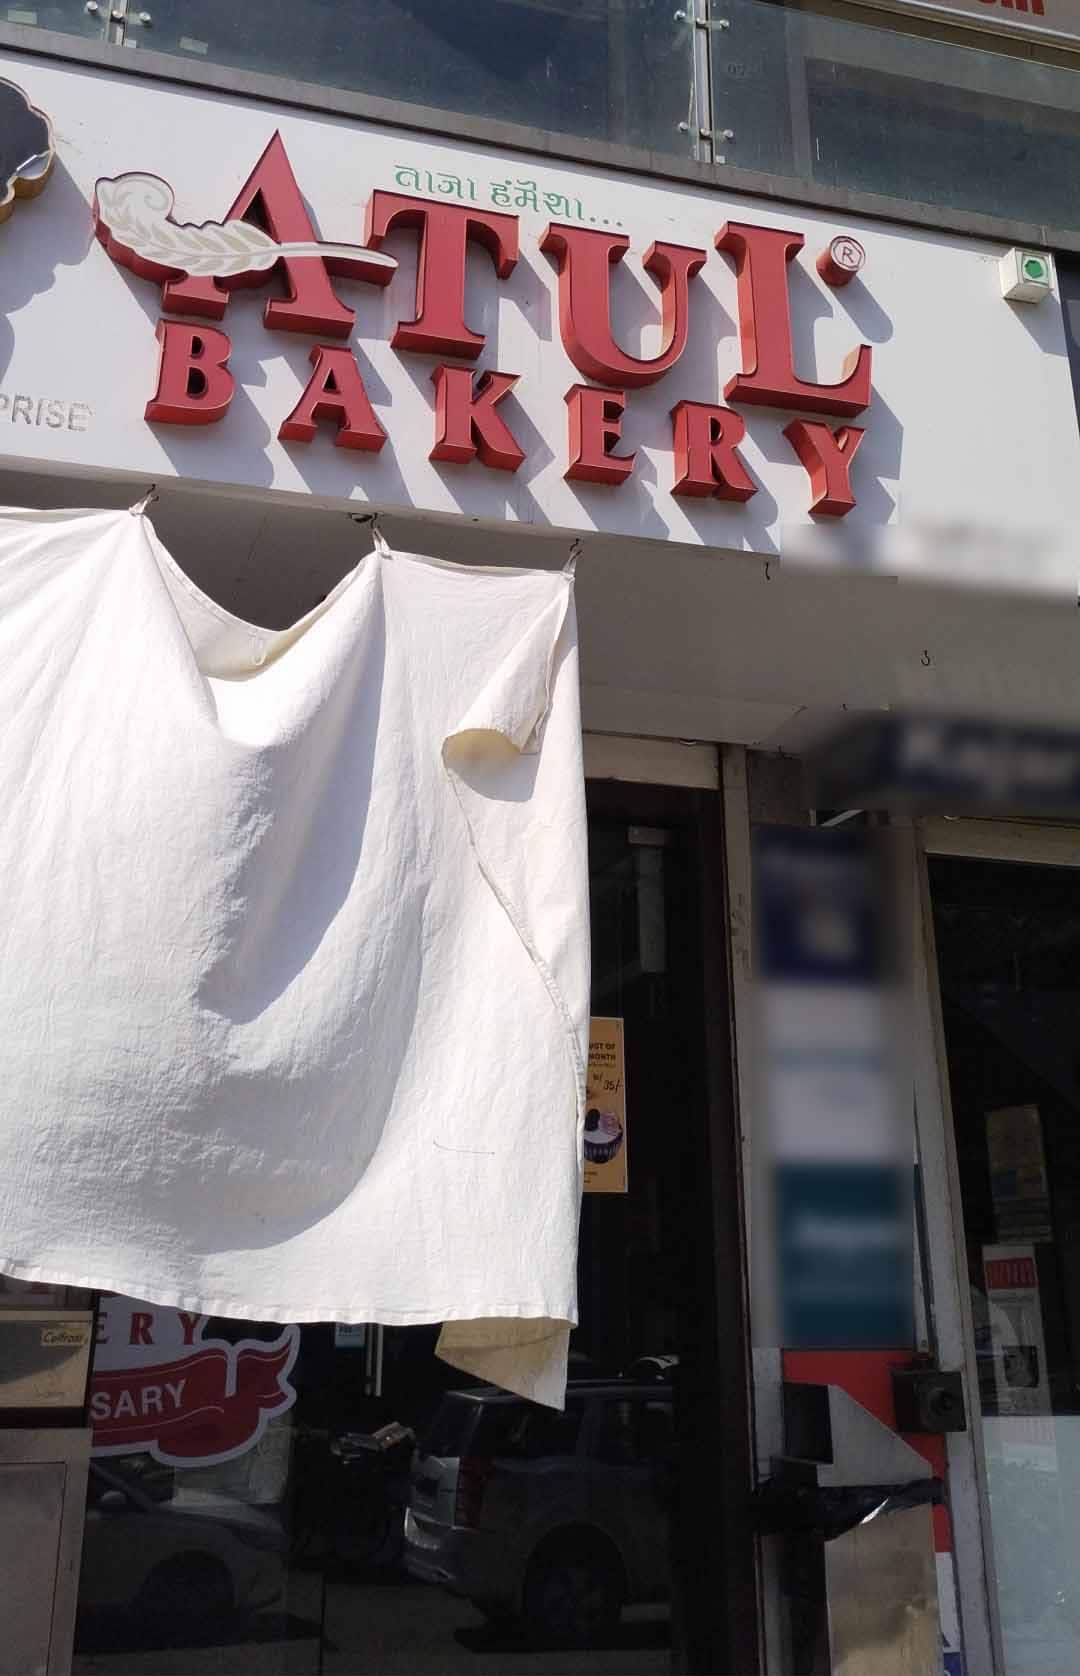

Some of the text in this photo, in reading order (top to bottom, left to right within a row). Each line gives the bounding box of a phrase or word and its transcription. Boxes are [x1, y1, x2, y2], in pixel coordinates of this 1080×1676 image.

[394, 164, 477, 201] તાજા
[162, 129, 873, 418] ATUL
[145, 318, 865, 518] BAKERY
[90, 1378, 187, 1420] SARY
